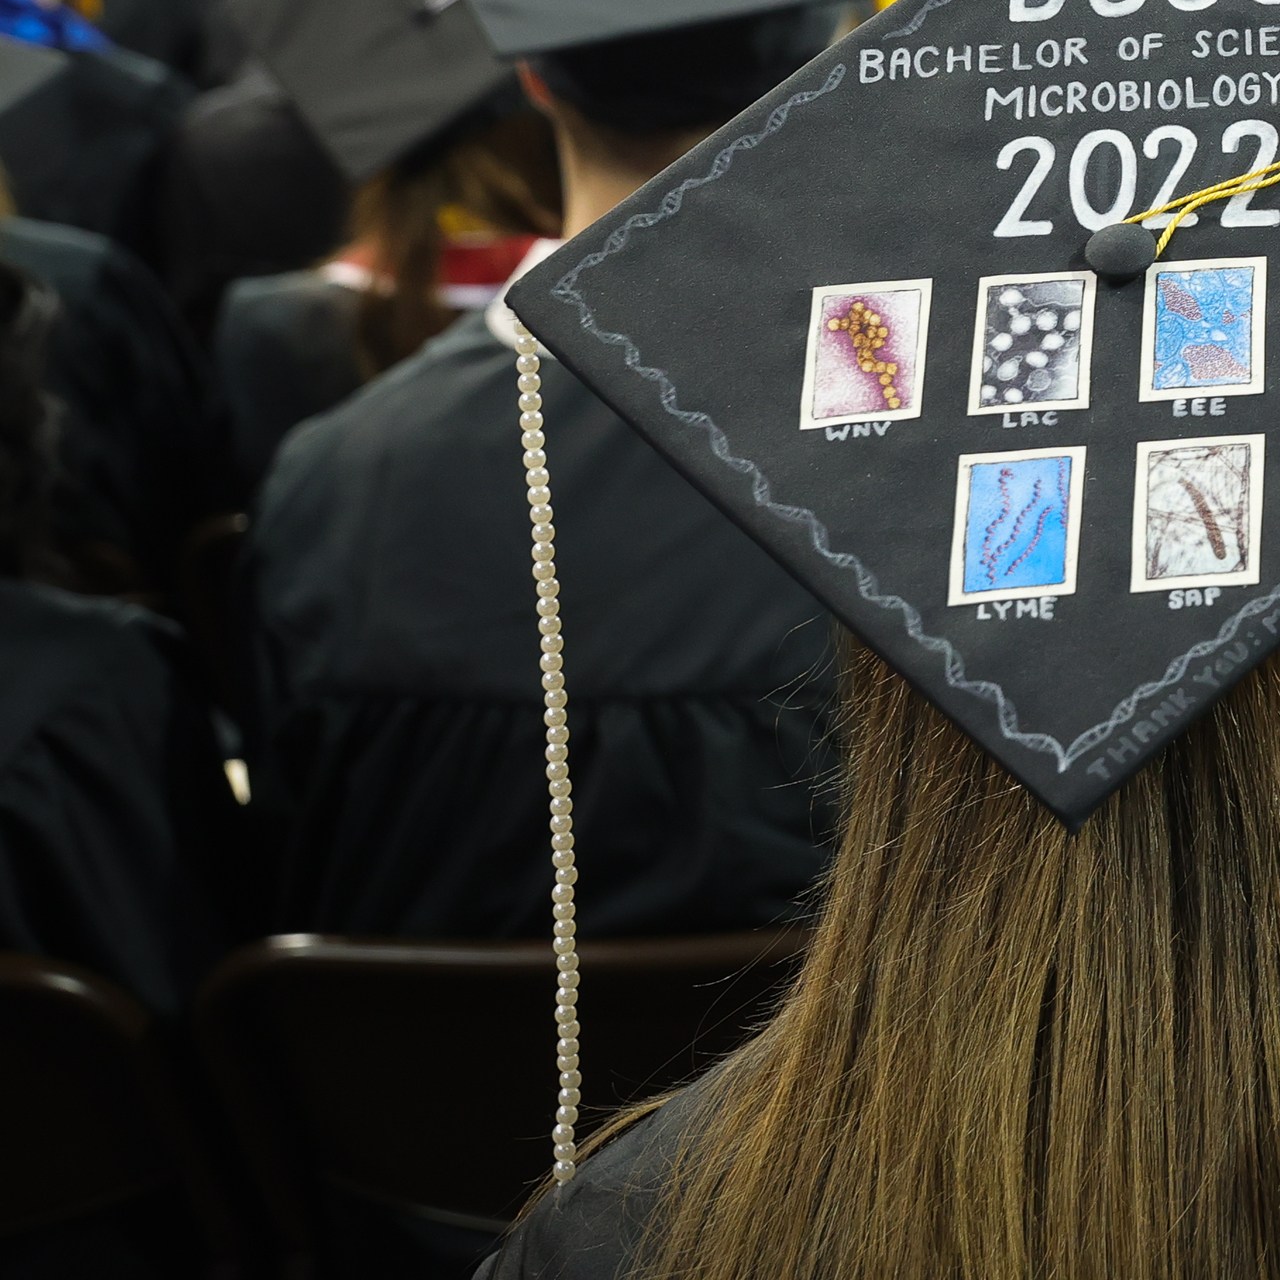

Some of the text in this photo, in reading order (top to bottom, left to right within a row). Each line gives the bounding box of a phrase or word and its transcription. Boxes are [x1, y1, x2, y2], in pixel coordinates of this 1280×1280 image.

[858, 35, 1088, 84] BACHELOR
[1117, 31, 1164, 61] OF
[1171, 397, 1228, 418] EEE
[824, 420, 893, 442] WNV
[1002, 411, 1060, 429] LAC
[975, 595, 1060, 621] LYME
[1167, 586, 1223, 610] SAP
[1086, 687, 1197, 781] THANK
